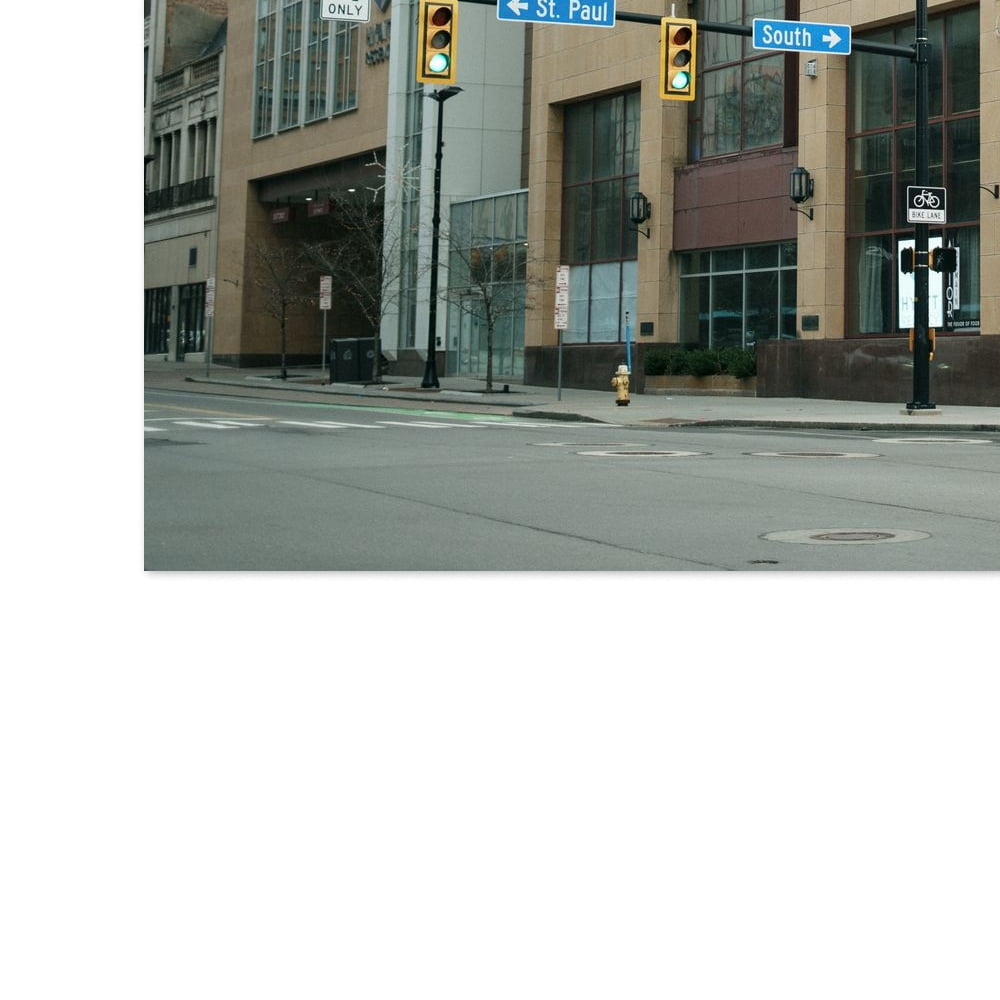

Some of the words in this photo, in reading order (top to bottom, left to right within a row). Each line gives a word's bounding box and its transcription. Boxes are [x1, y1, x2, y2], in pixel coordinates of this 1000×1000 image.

[328, 3, 363, 16] ONLY
[762, 25, 811, 47] South
[927, 211, 942, 219] LANE
